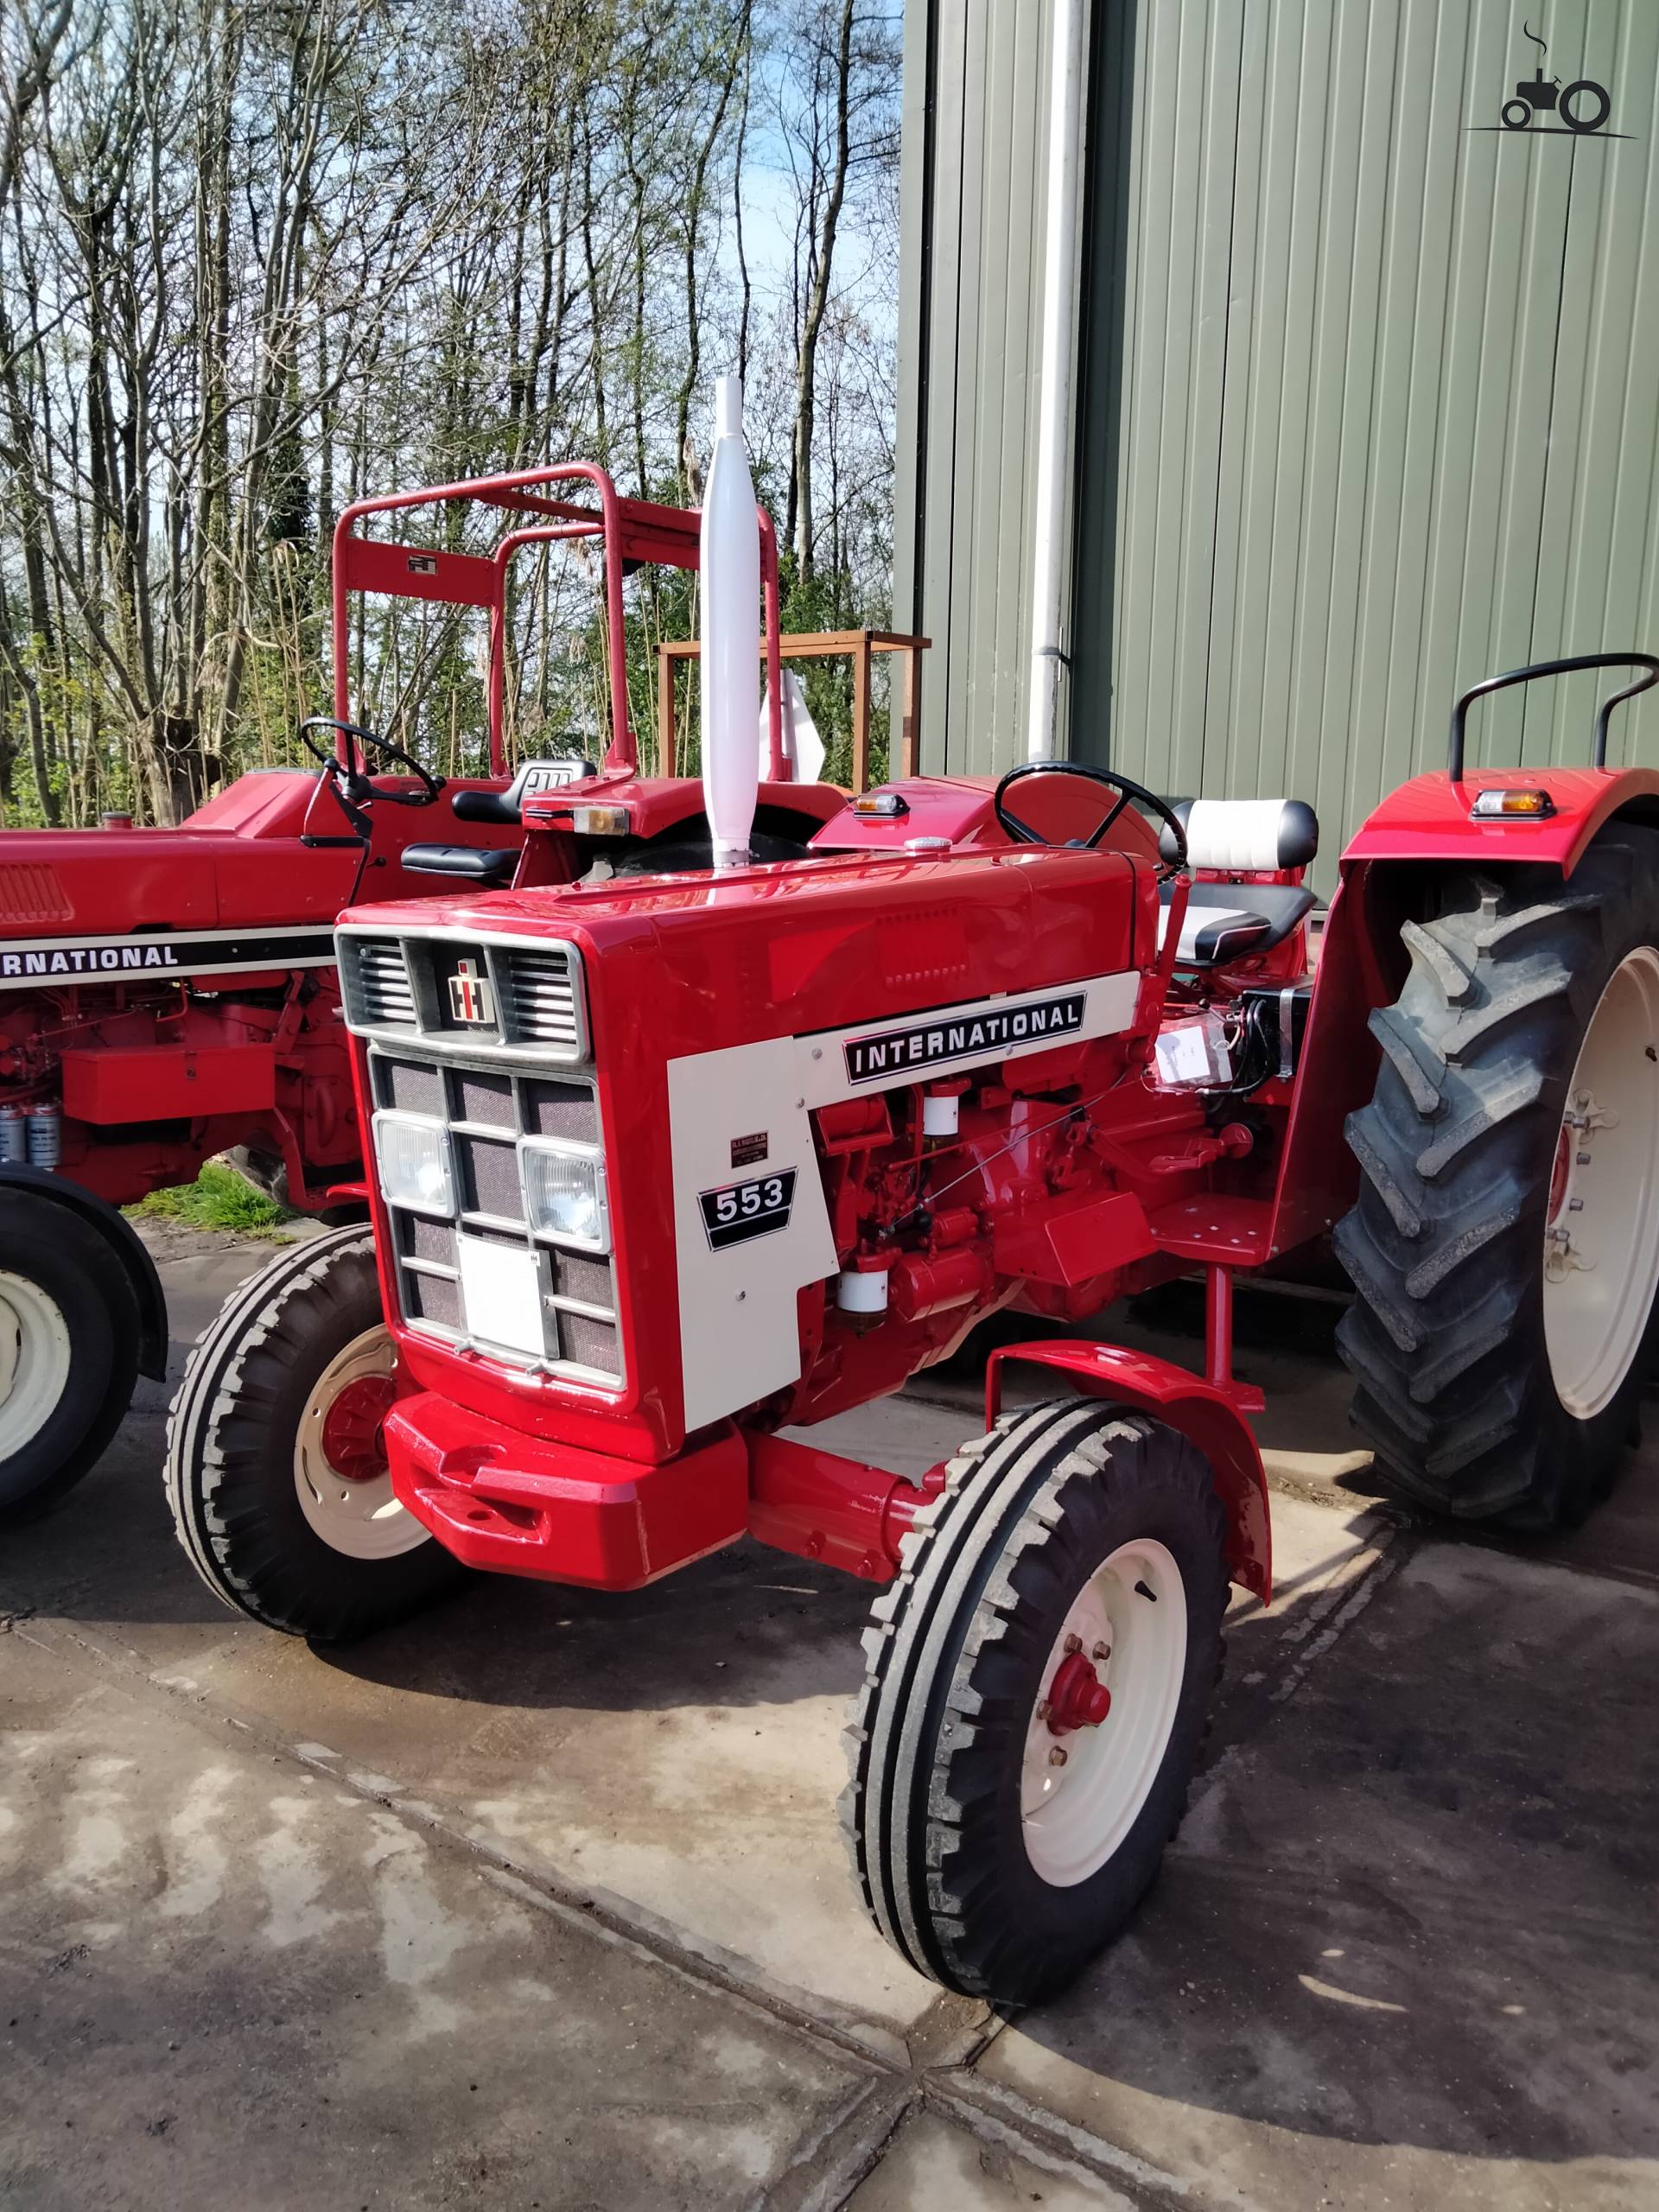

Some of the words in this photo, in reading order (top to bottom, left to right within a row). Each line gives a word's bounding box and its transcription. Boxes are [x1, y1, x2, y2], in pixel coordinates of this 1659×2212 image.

[3, 946, 178, 976] RNATIONAL
[855, 1004, 1078, 1072] INTERNATIONAL
[716, 1179, 783, 1222] 553
